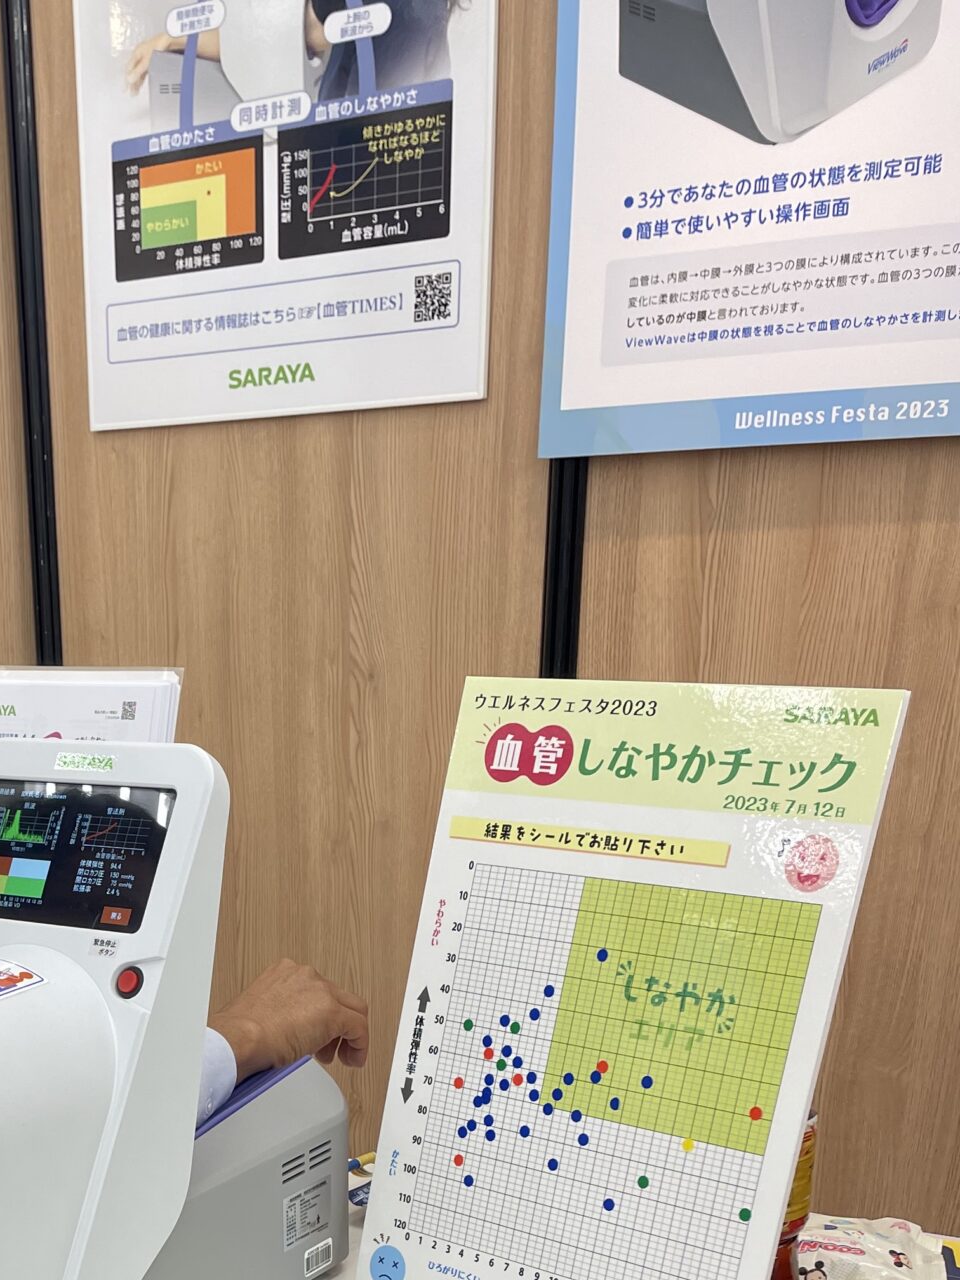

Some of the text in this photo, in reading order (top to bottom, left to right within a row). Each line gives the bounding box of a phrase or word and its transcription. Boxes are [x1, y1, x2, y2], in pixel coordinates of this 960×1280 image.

[315, 89, 419, 122] 血管のしなやかさ
[239, 96, 301, 127] 同時計測
[362, 114, 446, 140] 傾きがゆるやかに
[148, 126, 216, 153] 血管のかたさ
[383, 148, 425, 165] しなやか
[195, 160, 223, 174] かたい
[637, 153, 943, 210] 3分であなたの血管の状態を測定可能
[416, 207, 423, 217] 5
[439, 204, 445, 214] 6
[372, 213, 378, 224] 3
[394, 210, 401, 220] 4
[635, 196, 851, 242] 簡単で使いやすい操作画面
[329, 221, 334, 230] 1
[350, 217, 357, 227] 2
[307, 223, 314, 233] 0
[341, 220, 409, 244] 血管容量(mL)
[628, 264, 960, 309] 変化に柔軟に対応できることがしなやかな状態です。血管の3つの膜
[625, 309, 960, 349] ViewWaveは中膜の状態を視ることで血管のしなやかさを計測し
[228, 362, 316, 390] SARAYA
[735, 398, 950, 430] Wellness Festa 2023
[474, 693, 658, 717] ウエルネスフェスタ2023
[783, 704, 880, 727] SARAYA
[483, 822, 684, 856] 結果をシールでお貼り下さい
[468, 860, 475, 870] 0
[459, 890, 469, 901] 10
[431, 898, 447, 946] やわらかい
[452, 922, 463, 932] 20
[93, 938, 117, 948] 緊急停止
[98, 948, 115, 957] ボタン
[446, 952, 457, 963] 30
[440, 983, 451, 994] 40
[624, 974, 736, 1018] しなやか
[434, 1014, 444, 1025] 50
[628, 1019, 705, 1052] エリア
[406, 1014, 425, 1076] 体積弾性率
[428, 1045, 439, 1056] 60
[423, 1075, 433, 1086] 70
[417, 1104, 428, 1115] 80
[412, 1135, 422, 1146] 90
[388, 1149, 400, 1177] かたい
[403, 1163, 417, 1175] 100
[398, 1192, 412, 1204] 110
[394, 1218, 407, 1230] 120
[404, 1232, 410, 1241] 0
[418, 1236, 423, 1245] 1
[431, 1240, 438, 1250] 2
[445, 1244, 451, 1254] 3
[458, 1249, 464, 1258] 4
[474, 1253, 480, 1263] 5
[488, 1258, 495, 1268] 6
[504, 1262, 510, 1272] 7
[518, 1267, 525, 1277] 8
[534, 1271, 540, 1280] 9
